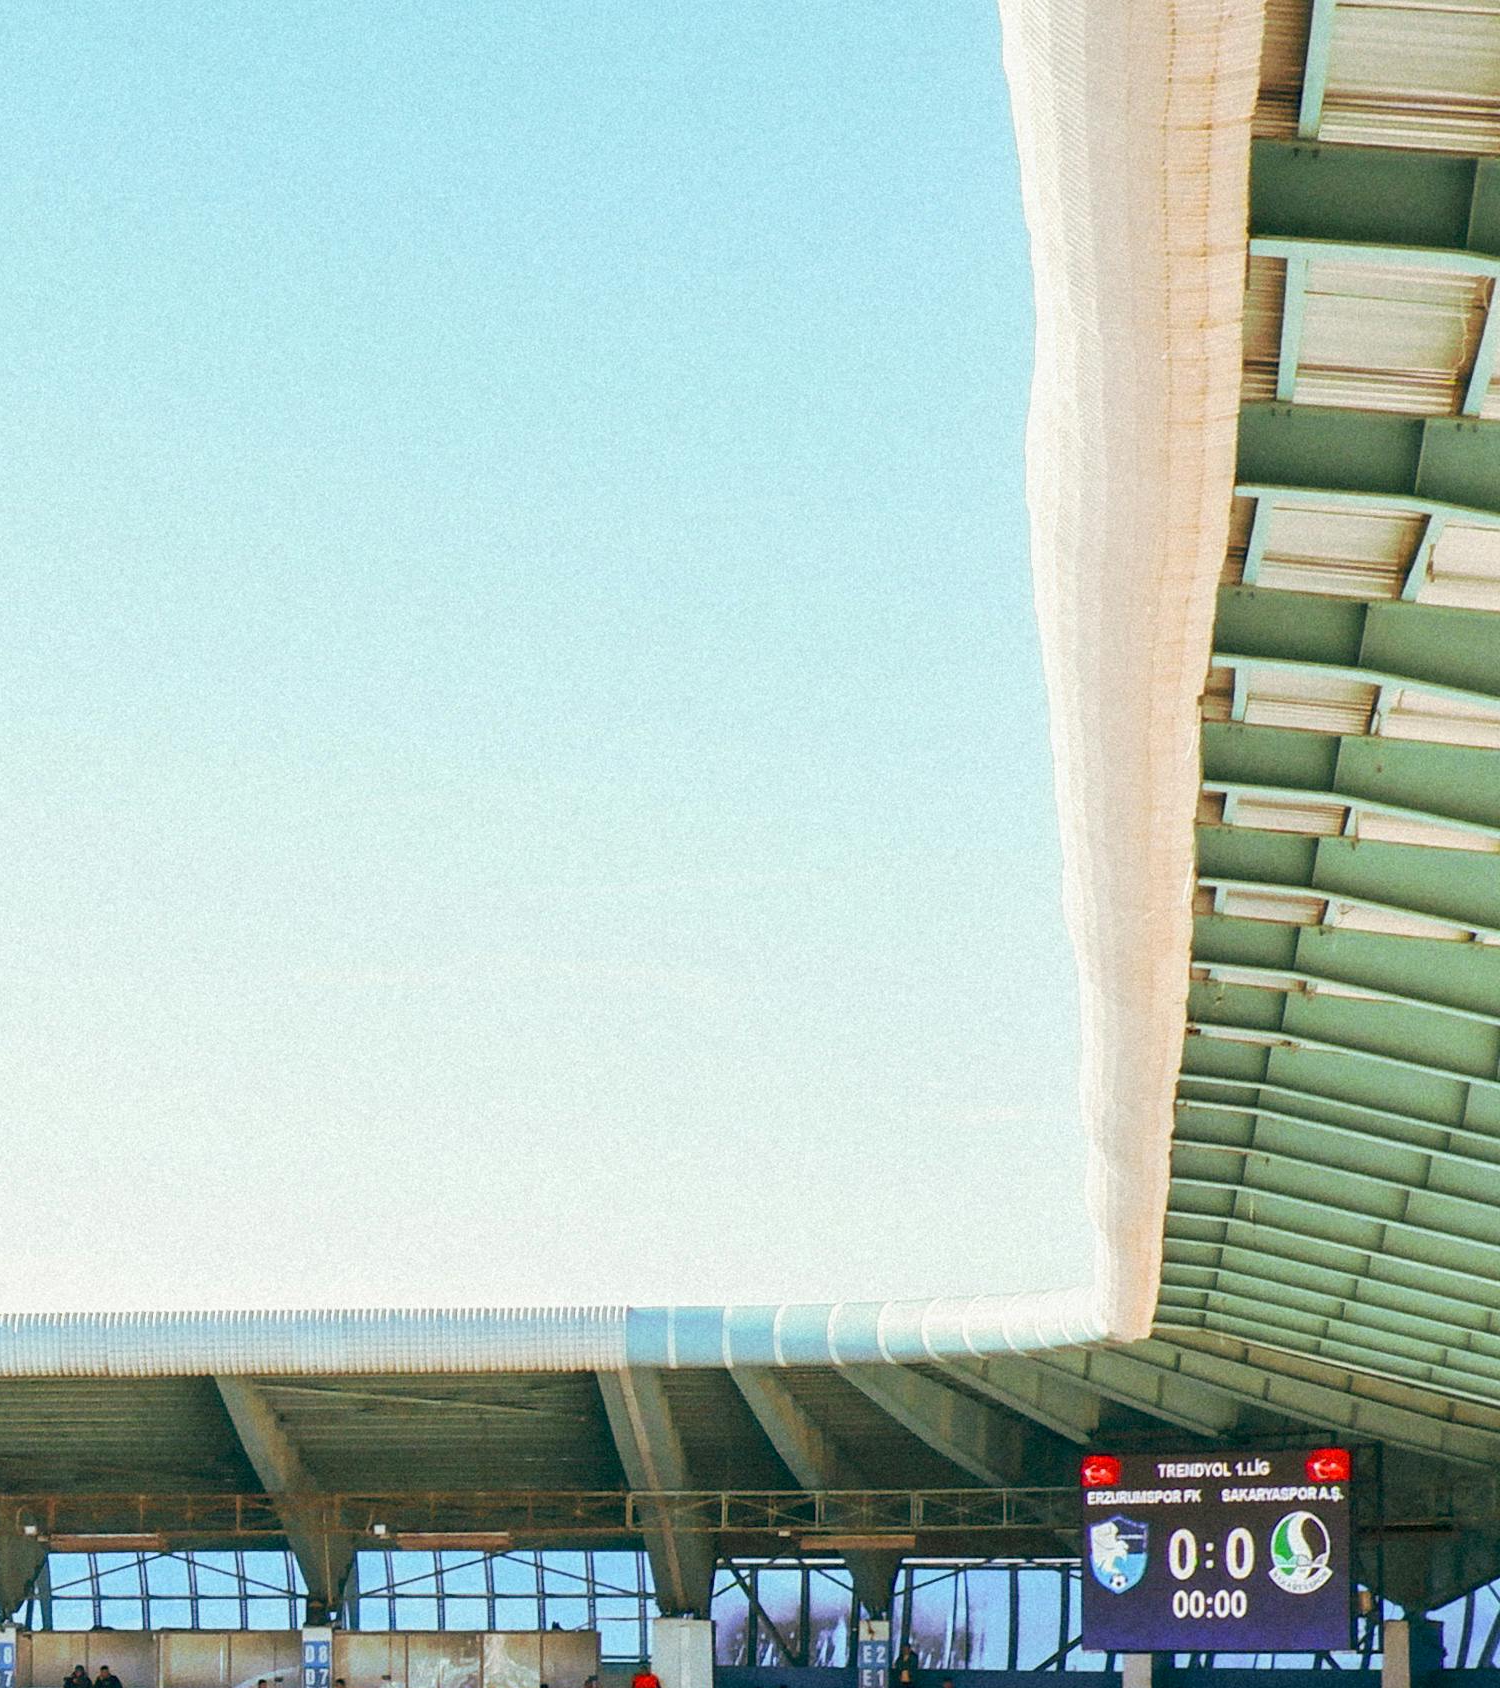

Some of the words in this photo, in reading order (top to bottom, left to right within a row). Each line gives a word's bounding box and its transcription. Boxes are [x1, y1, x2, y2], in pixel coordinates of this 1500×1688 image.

[1157, 1463, 1232, 1478] TRENDYOL
[1087, 1489, 1182, 1505] ERZURUMSPOR
[1183, 1489, 1202, 1504] FK
[1221, 1486, 1318, 1503] SAKARYASPOR
[1172, 1589, 1247, 1619] 00:00
